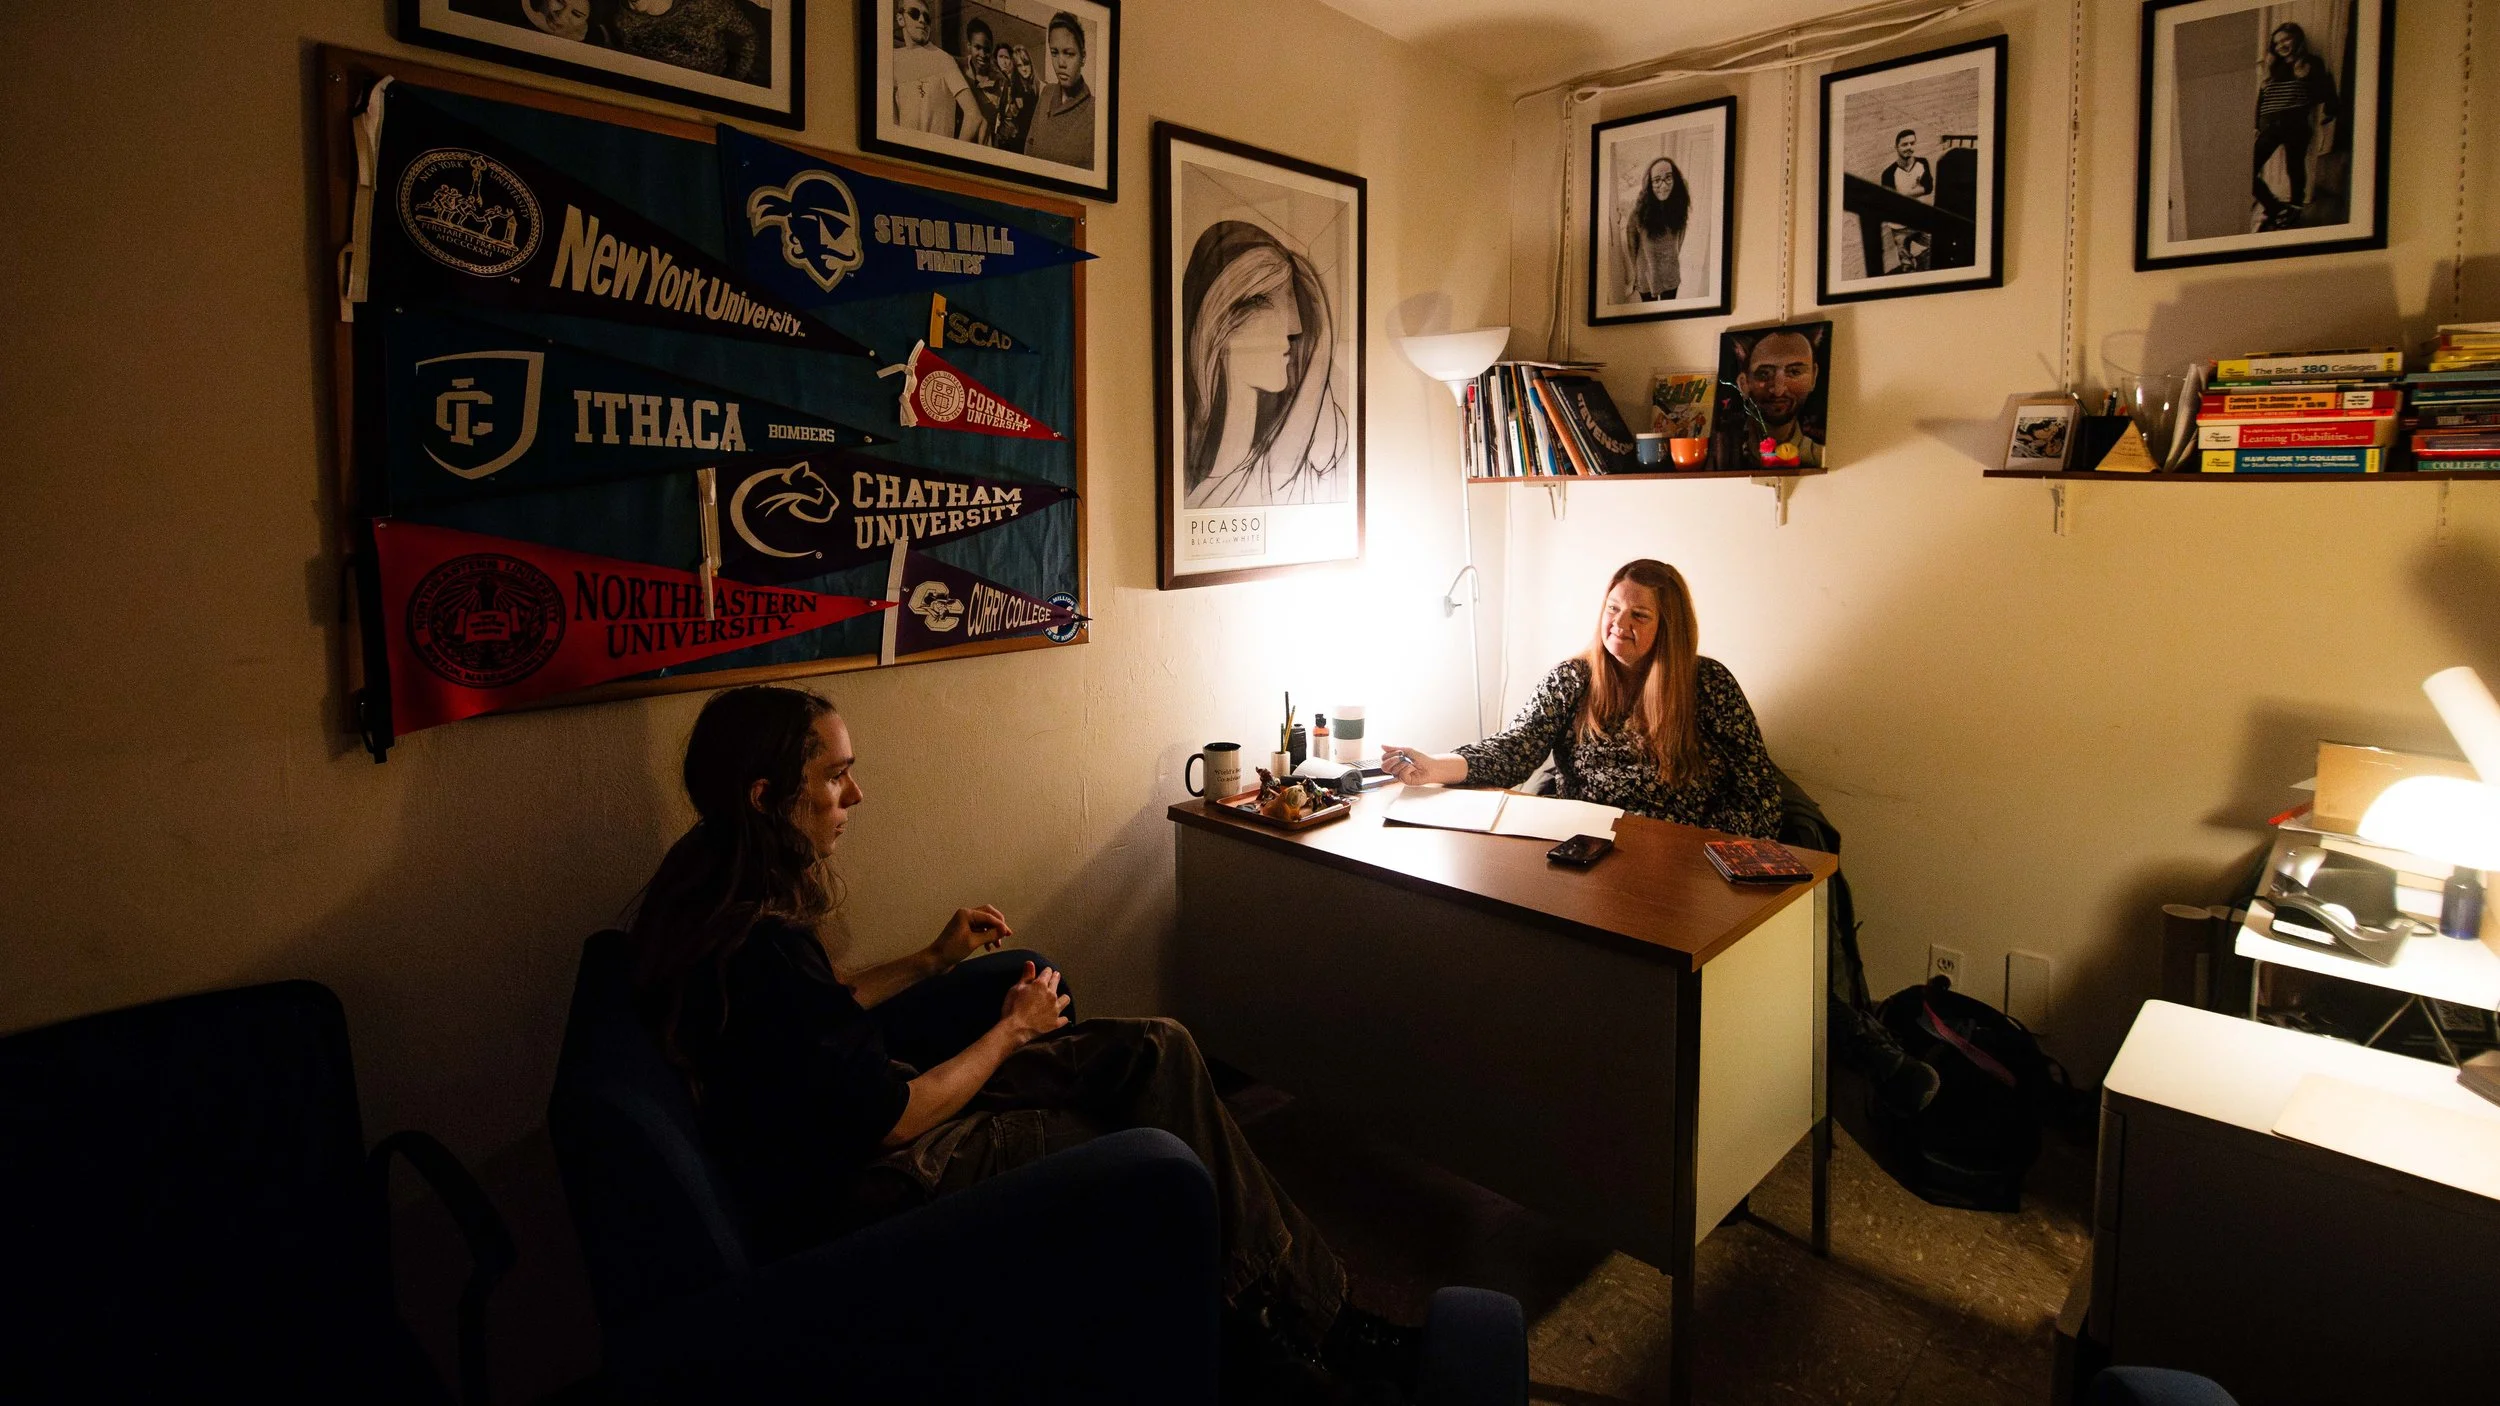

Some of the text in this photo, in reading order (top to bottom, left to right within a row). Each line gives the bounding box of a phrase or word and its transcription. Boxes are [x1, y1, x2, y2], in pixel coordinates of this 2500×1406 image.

[418, 160, 530, 219] NEW YORK UNIVERSITY
[874, 213, 1015, 256] SETON HALL
[550, 203, 802, 337] New York University
[914, 249, 986, 275] PIRATES
[946, 312, 1012, 351] SCAD
[2302, 364, 2328, 374] 380
[2331, 364, 2377, 373] Colleges
[573, 389, 836, 452] ITHACA BOMBERS
[966, 408, 1029, 433] UNIVERSITY
[967, 387, 1031, 429] CORNELL
[2242, 434, 2289, 444] Learning
[2290, 431, 2348, 442] Disabilities
[2432, 461, 2486, 471] COLLEGE
[852, 470, 1023, 510] CHATHAM
[853, 502, 1022, 550] UNIVERSITY
[1191, 517, 1261, 535] PICASSO
[1191, 537, 1220, 546] BLACK
[1233, 534, 1260, 543] WHITE
[967, 582, 1052, 637] CURRY COLLEGE
[1052, 595, 1076, 607] MILLION
[607, 613, 792, 659] UNIVERSITY
